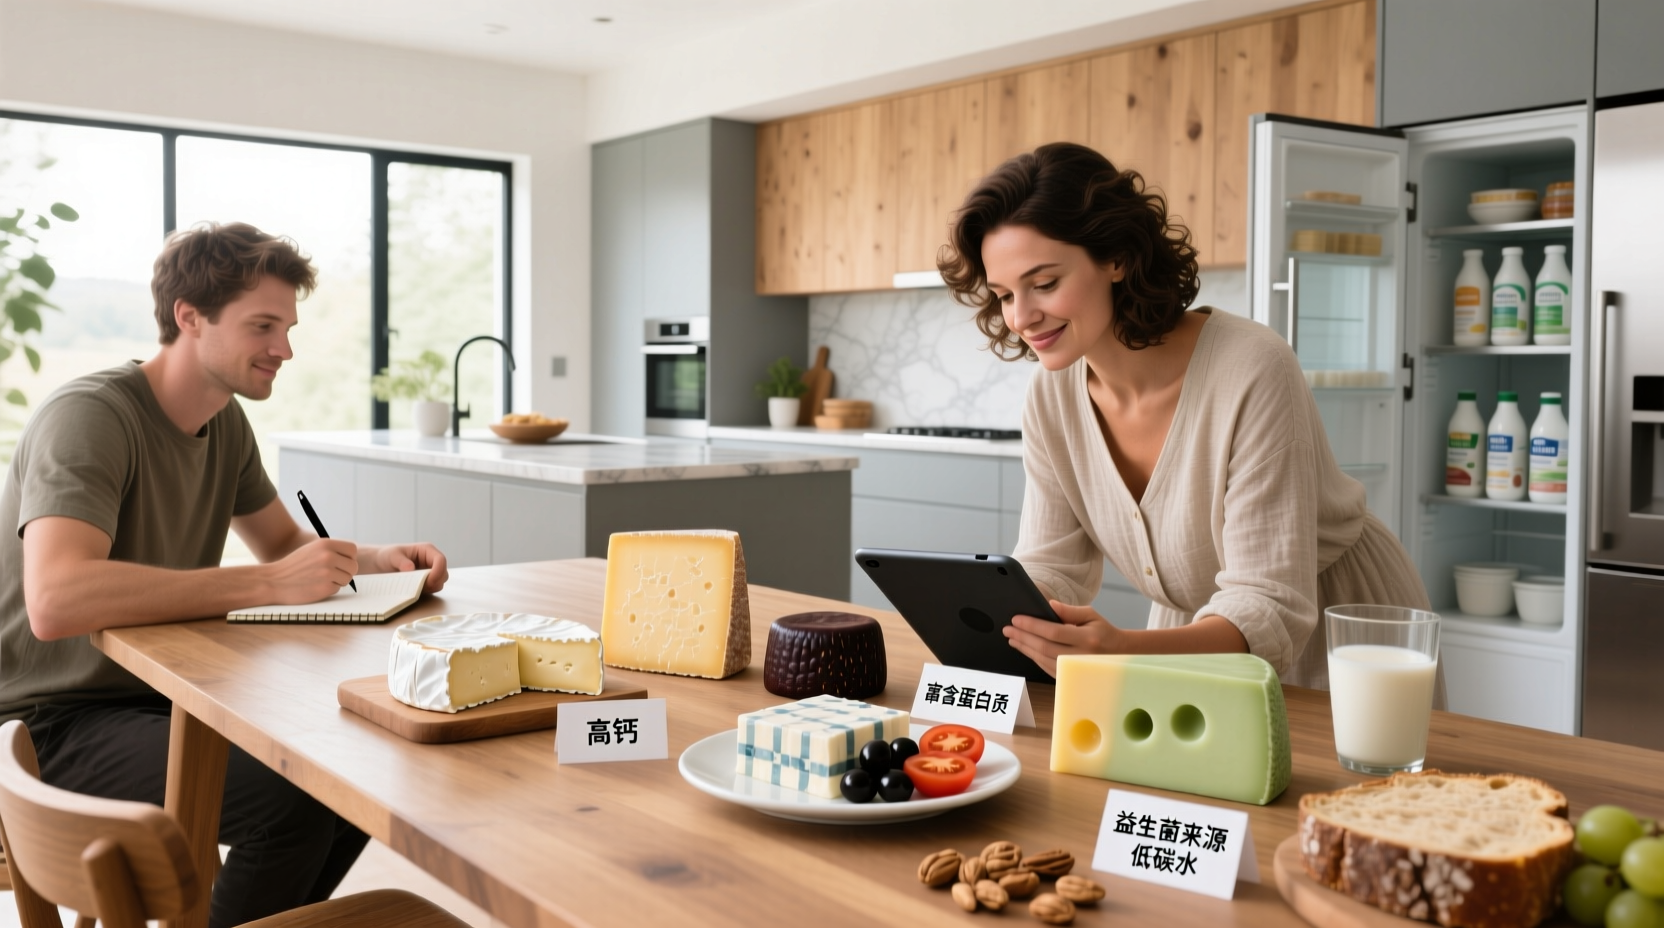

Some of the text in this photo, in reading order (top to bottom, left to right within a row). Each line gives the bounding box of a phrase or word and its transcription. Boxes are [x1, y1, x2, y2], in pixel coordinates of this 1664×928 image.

[586, 718, 639, 746] 高钙
[1113, 810, 1229, 853] 益生菌来源
[1131, 843, 1198, 876] 低碳水
